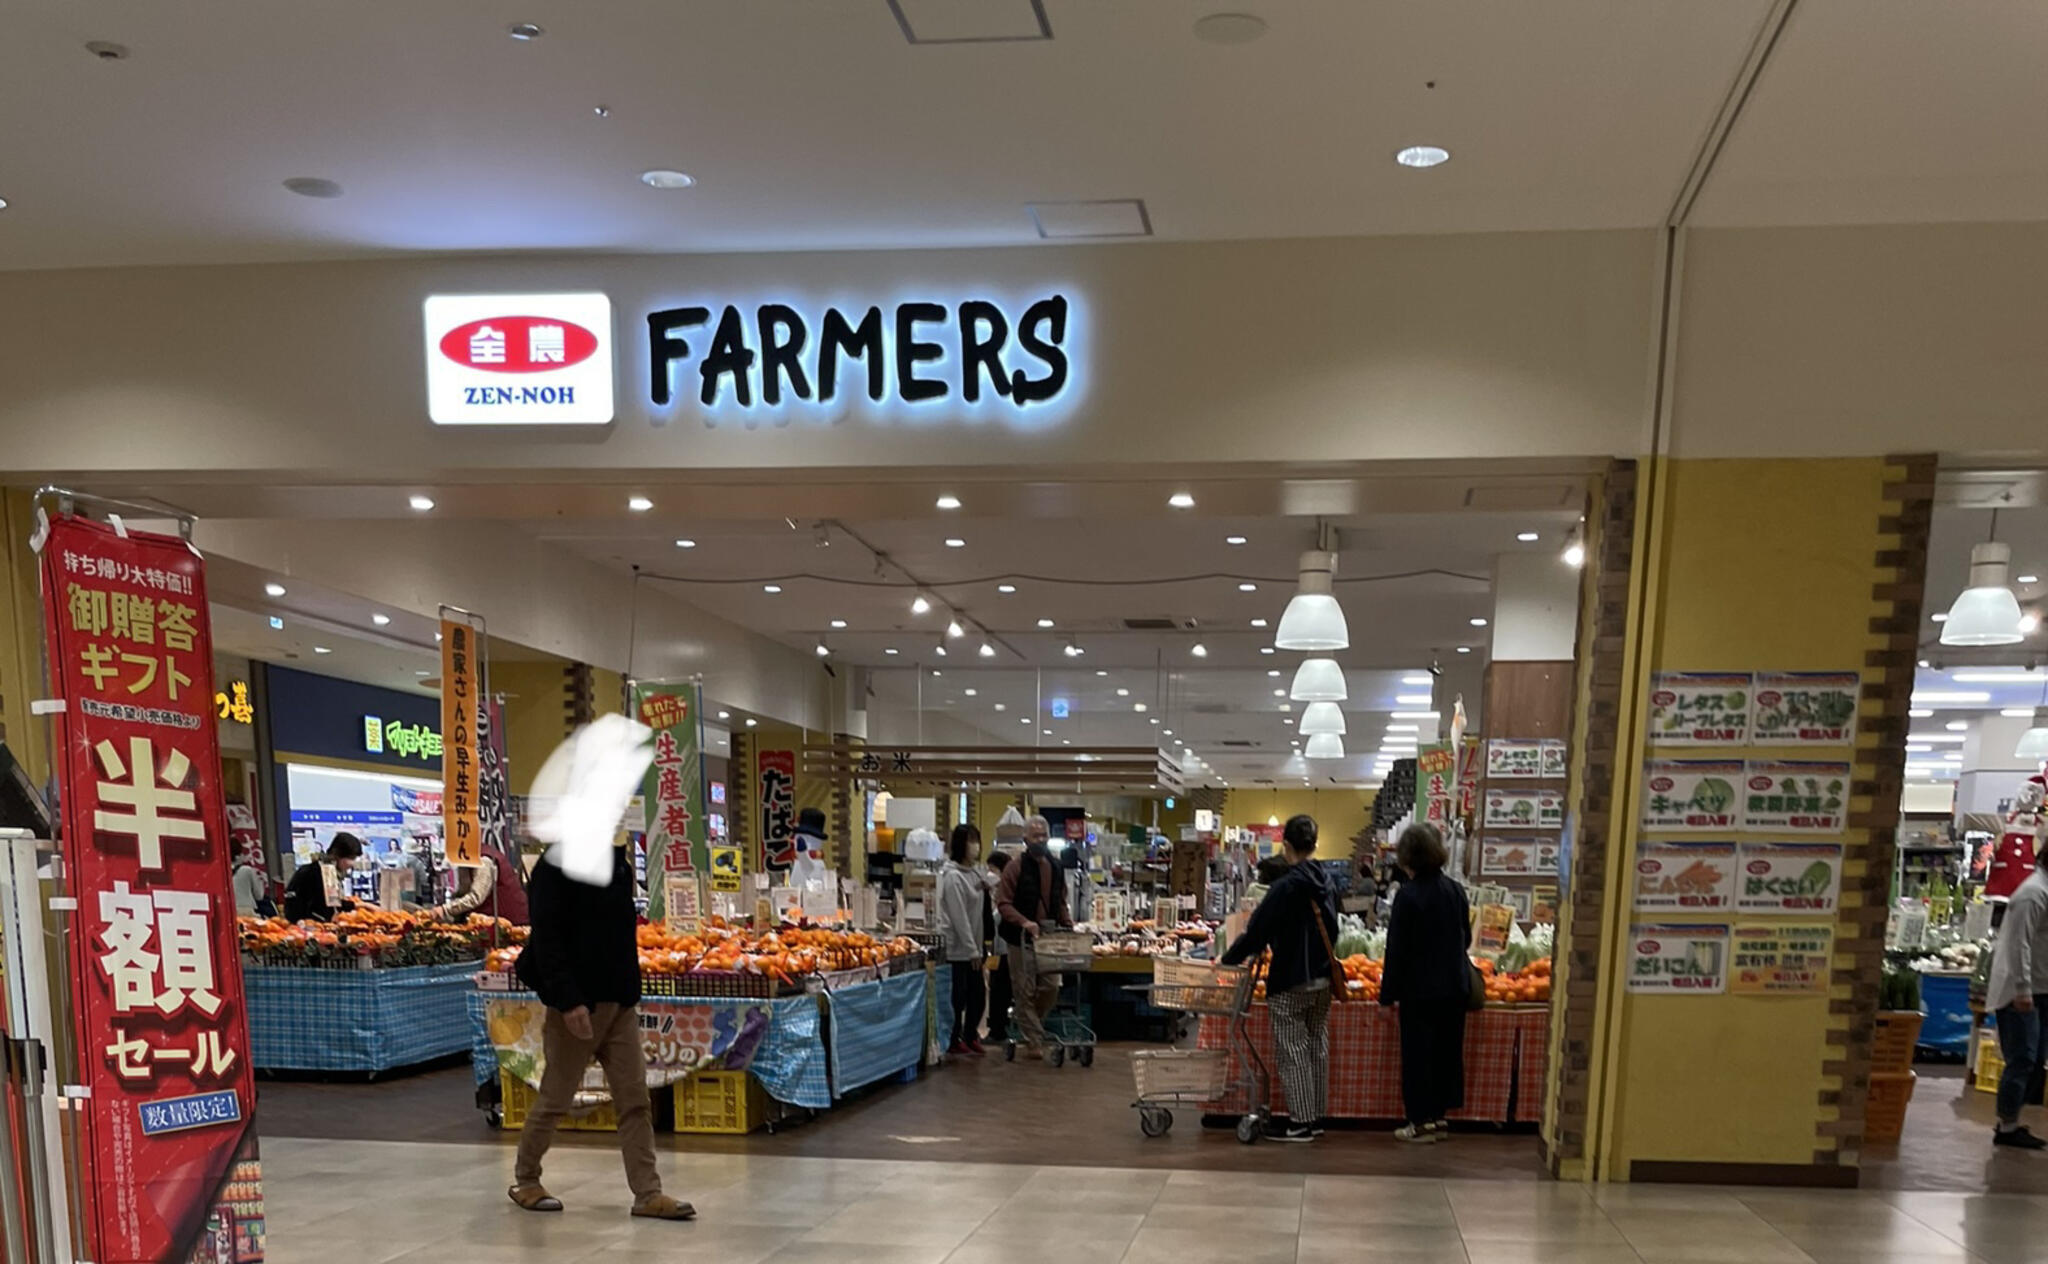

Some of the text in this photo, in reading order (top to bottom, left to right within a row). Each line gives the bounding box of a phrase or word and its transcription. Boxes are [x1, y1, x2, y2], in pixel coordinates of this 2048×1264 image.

[468, 326, 565, 363] 全農
[647, 294, 1068, 407] FARMERS
[464, 386, 574, 405] ZEN-NOH
[67, 582, 198, 652] 御贈答
[81, 643, 192, 701] ギフト
[451, 627, 470, 861] 農家さんの早生みかん
[862, 752, 912, 772] お米
[762, 769, 793, 872] たばこ
[106, 1029, 236, 1077] セール
[146, 1094, 236, 1128] 数量限定!
